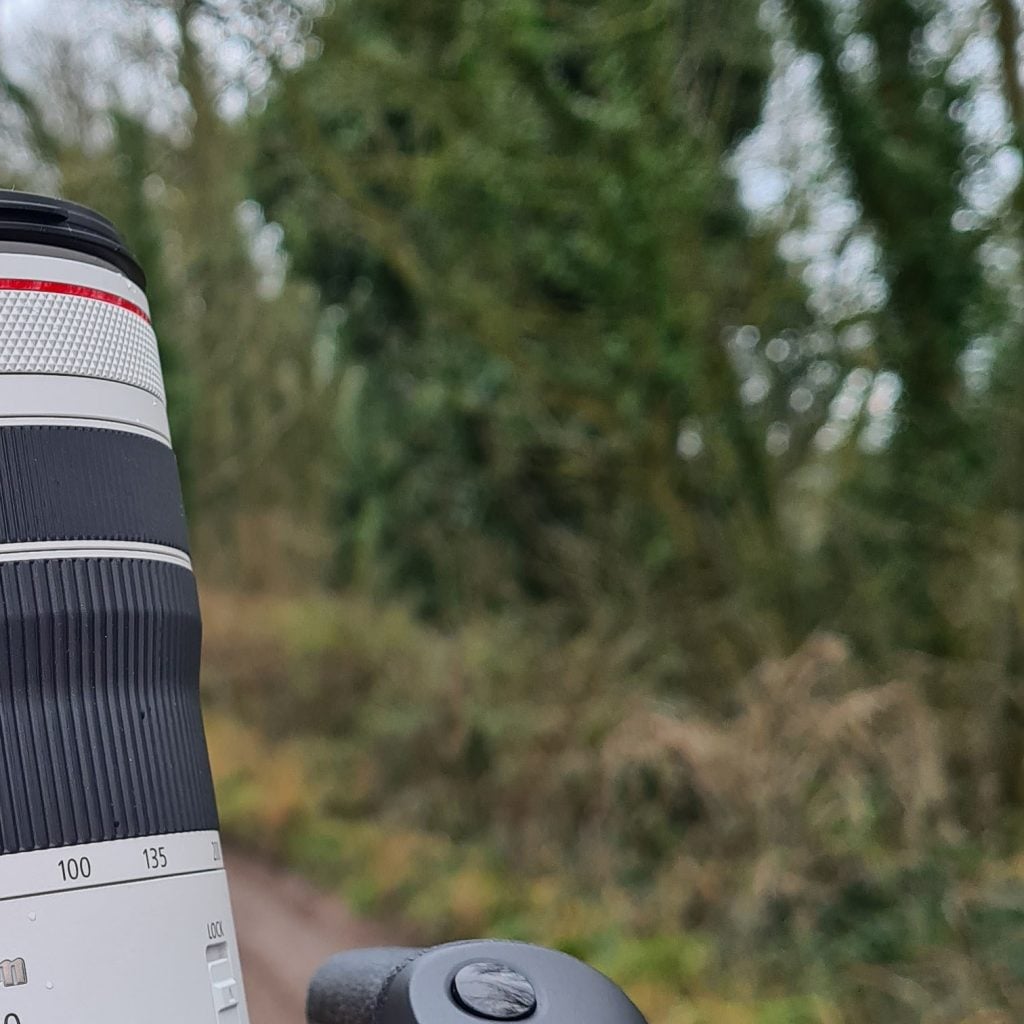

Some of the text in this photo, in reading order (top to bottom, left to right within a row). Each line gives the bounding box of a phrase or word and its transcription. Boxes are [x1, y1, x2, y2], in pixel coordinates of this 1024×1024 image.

[56, 856, 91, 881] 100
[142, 846, 168, 869] 135
[207, 921, 225, 940] LOCK
